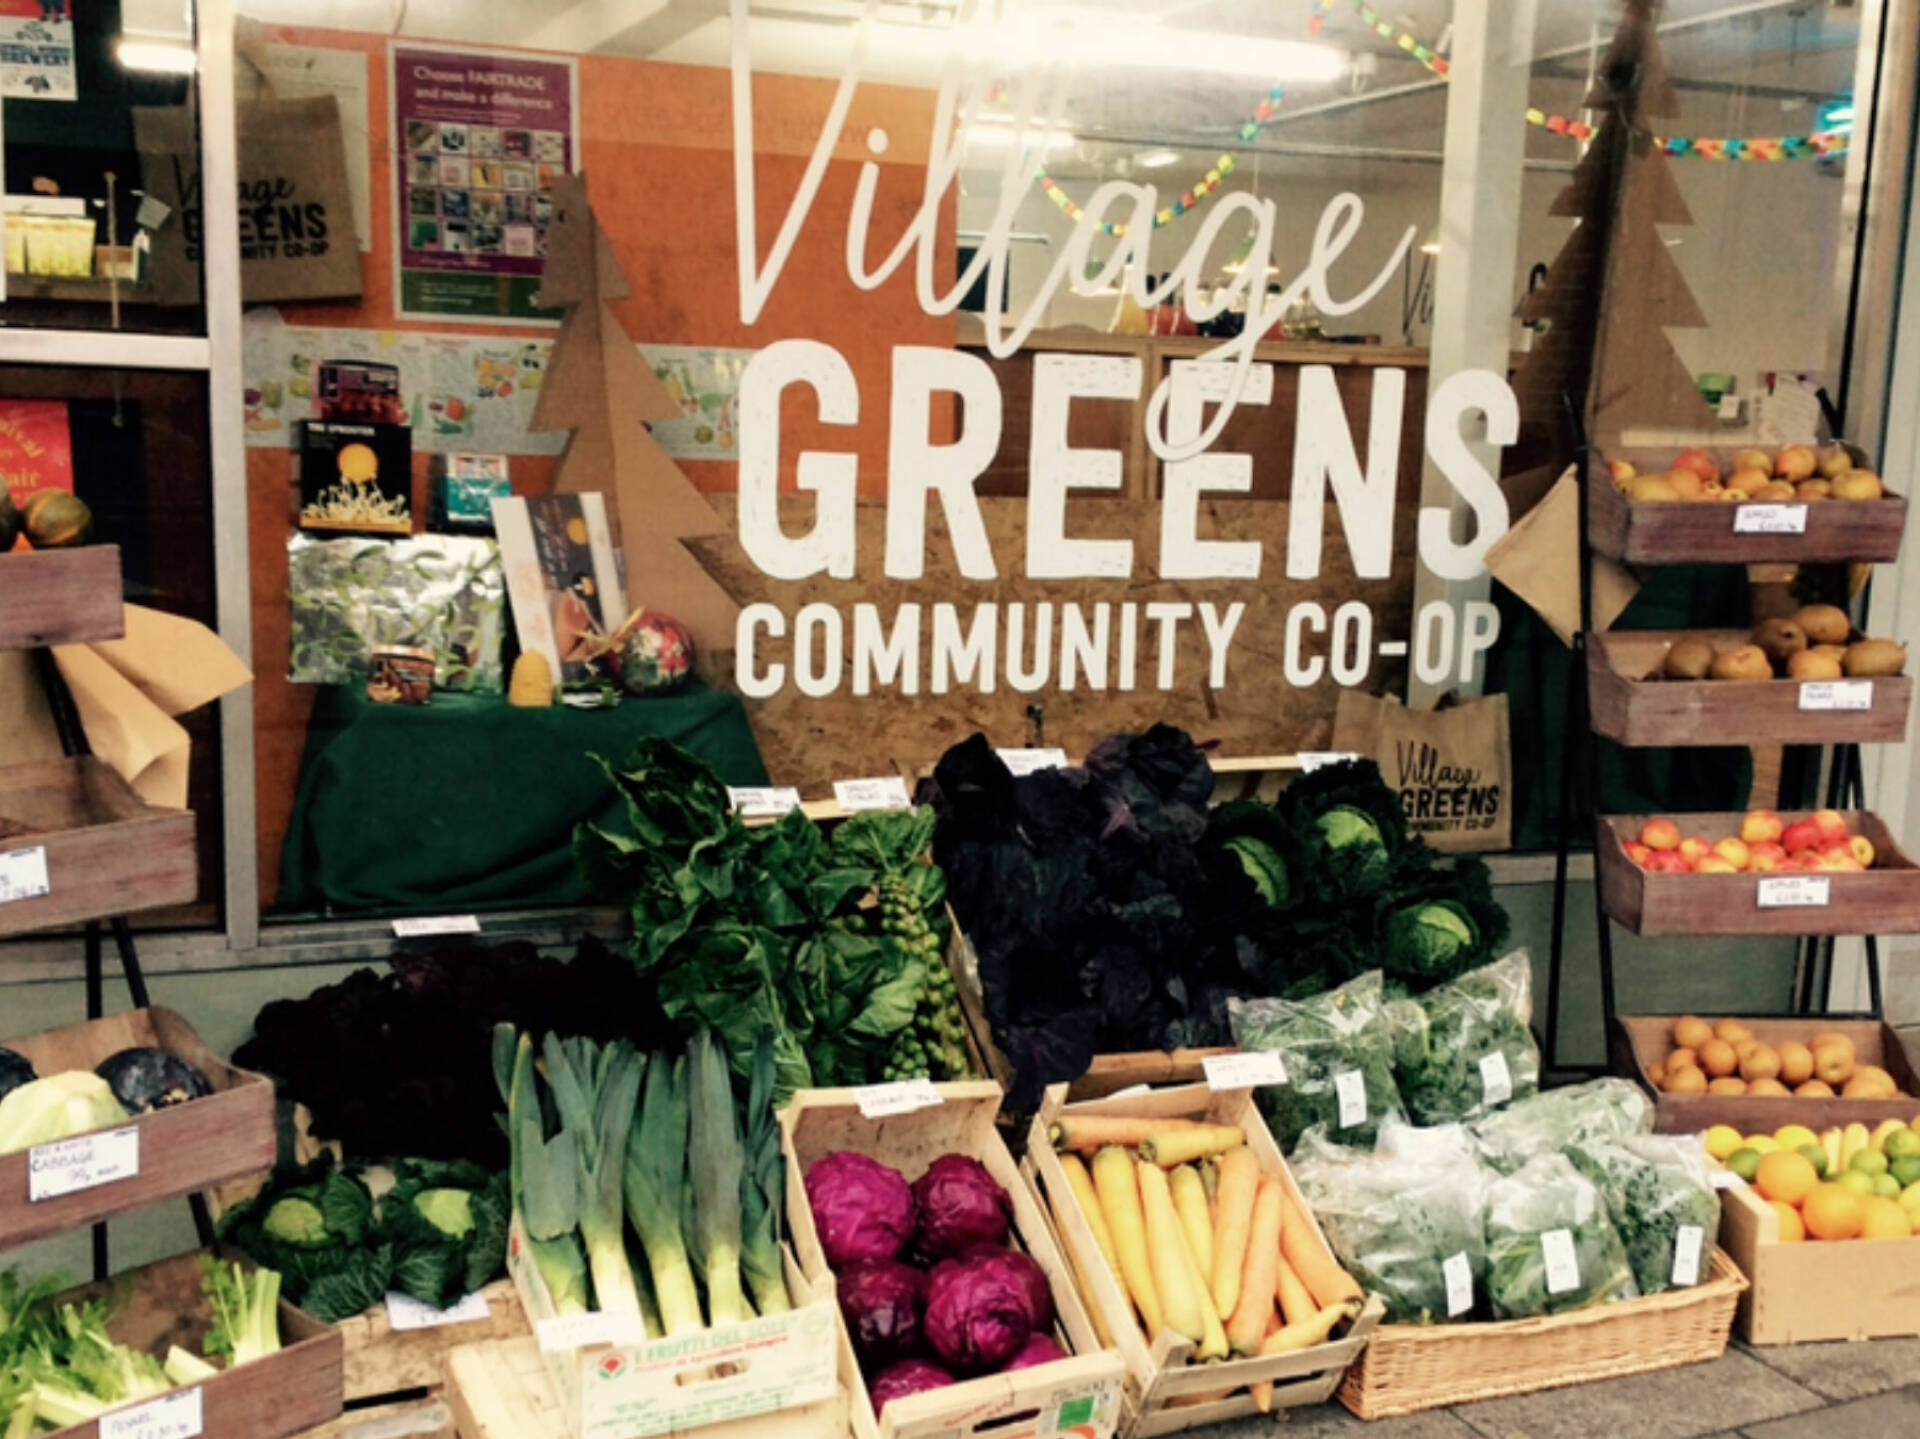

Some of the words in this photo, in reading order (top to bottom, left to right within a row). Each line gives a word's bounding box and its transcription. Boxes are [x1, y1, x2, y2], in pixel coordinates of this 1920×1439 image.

[413, 66, 464, 83] Choose
[467, 70, 545, 90] FAIRTRADE
[729, 0, 1418, 462] Village
[737, 339, 1520, 581] GREENS
[735, 602, 1245, 698] COMMUNITY
[1282, 600, 1501, 691] CO-OP
[1397, 739, 1482, 790] Village
[1400, 785, 1500, 818] GREENS
